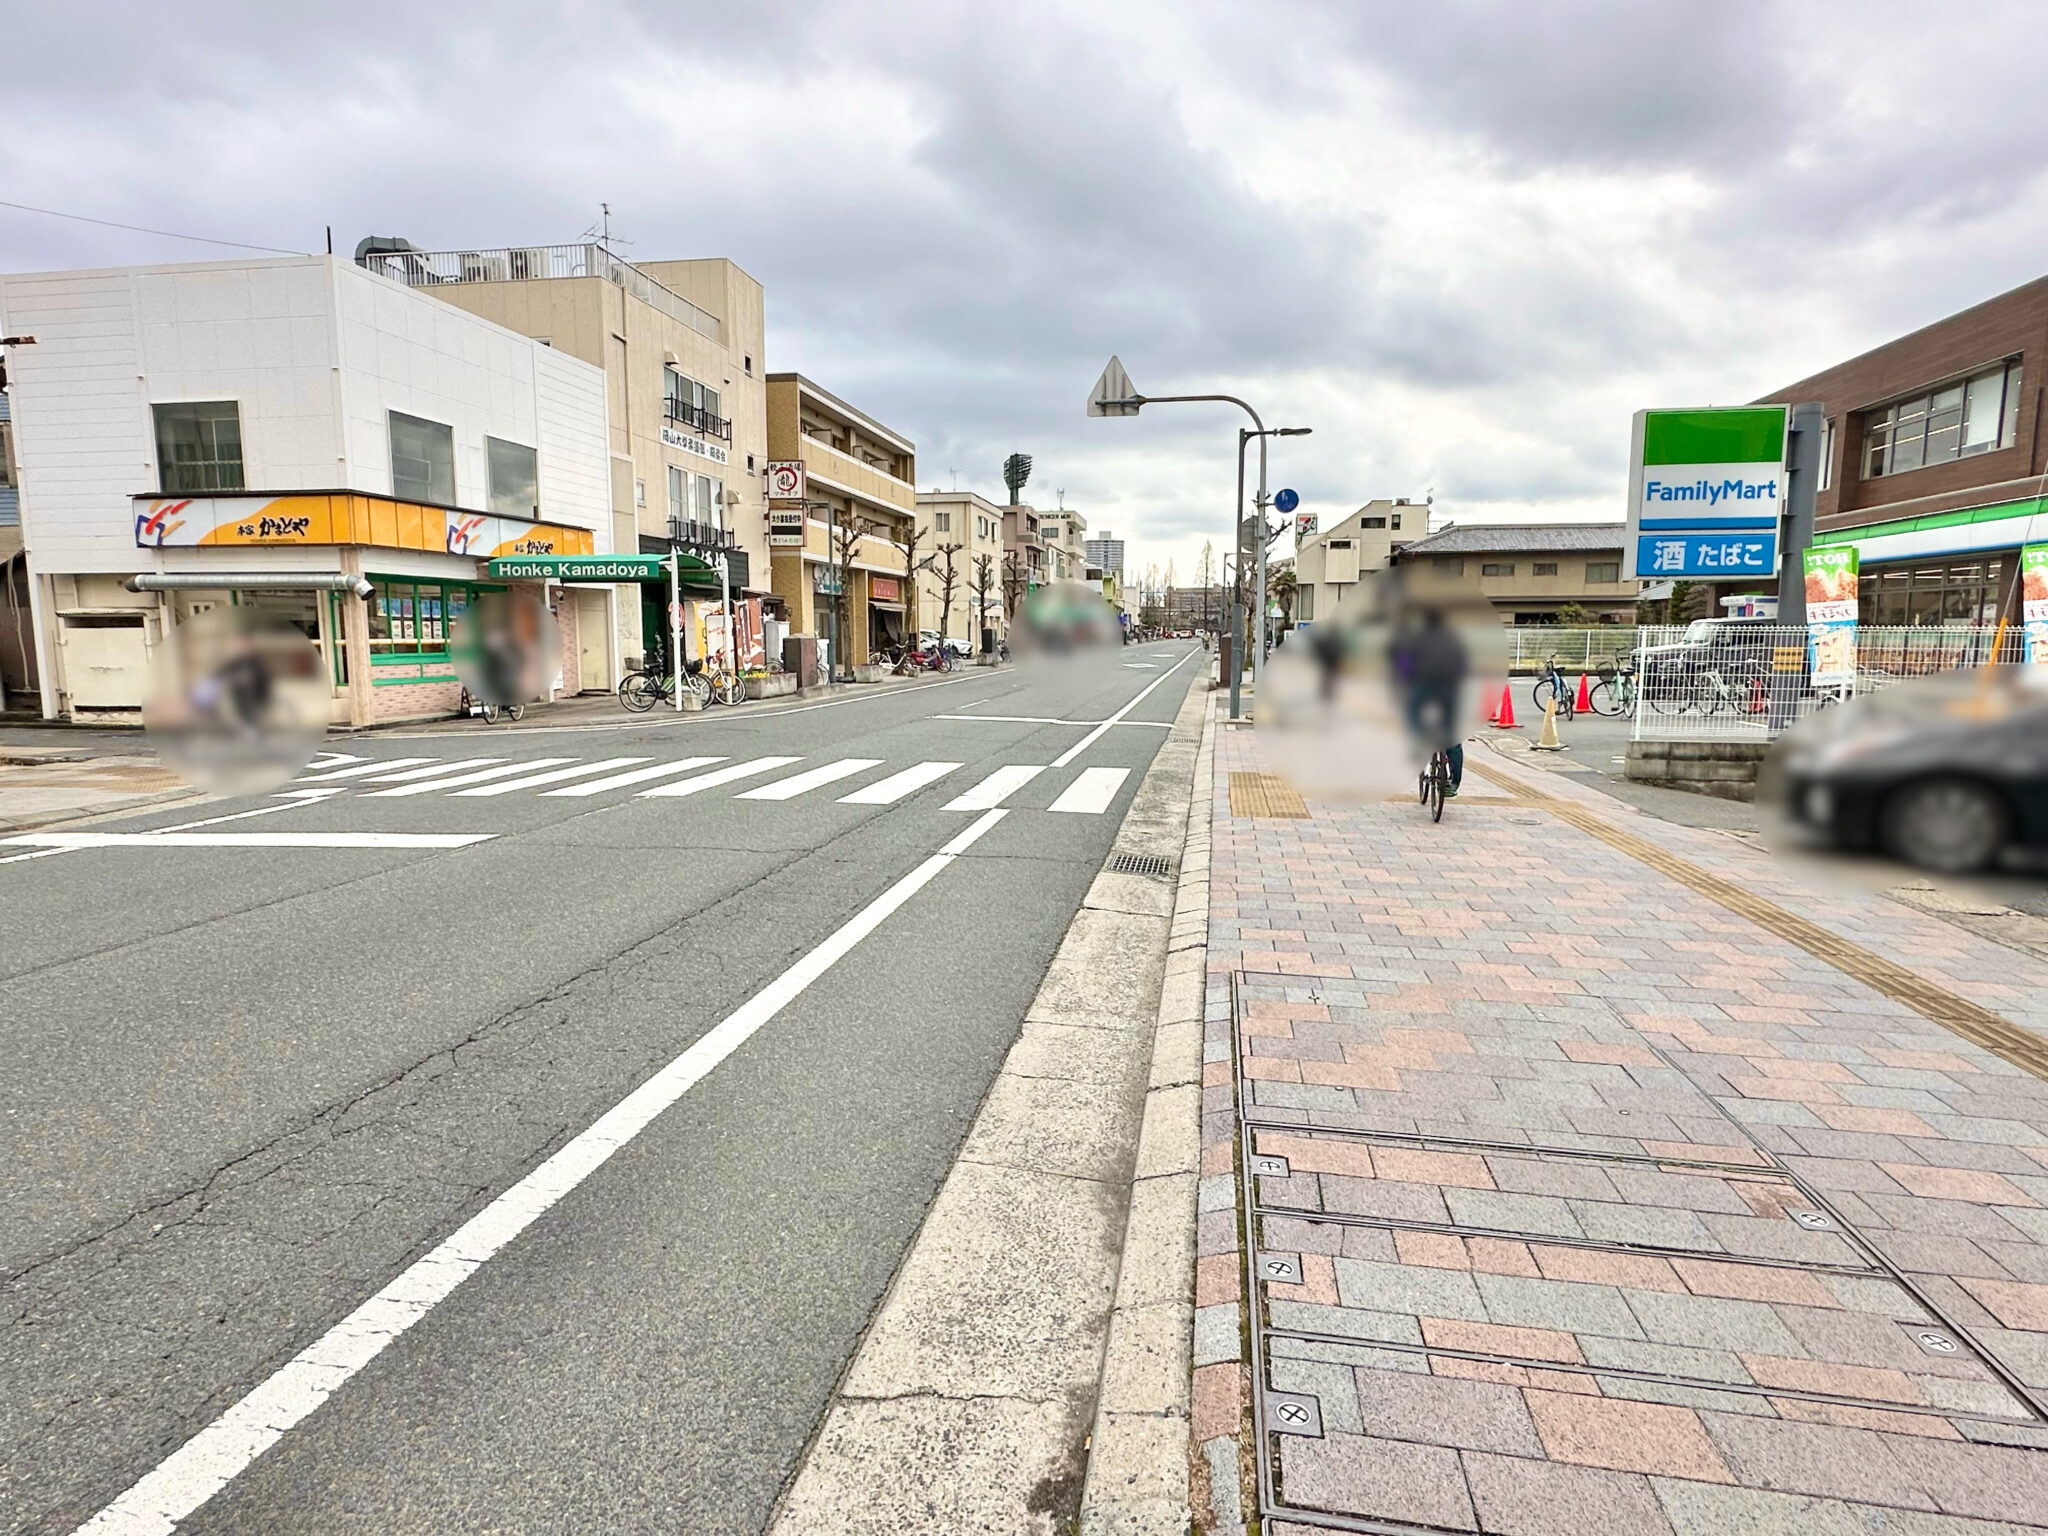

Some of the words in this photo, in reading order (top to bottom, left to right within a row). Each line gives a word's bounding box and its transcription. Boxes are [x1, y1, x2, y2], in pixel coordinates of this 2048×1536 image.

[1646, 480, 1777, 505] FamilyMart
[1653, 541, 1687, 571] 酒
[1697, 543, 1763, 567] たばこ
[499, 563, 553, 577] Honke
[558, 563, 649, 577] Kamadoya
